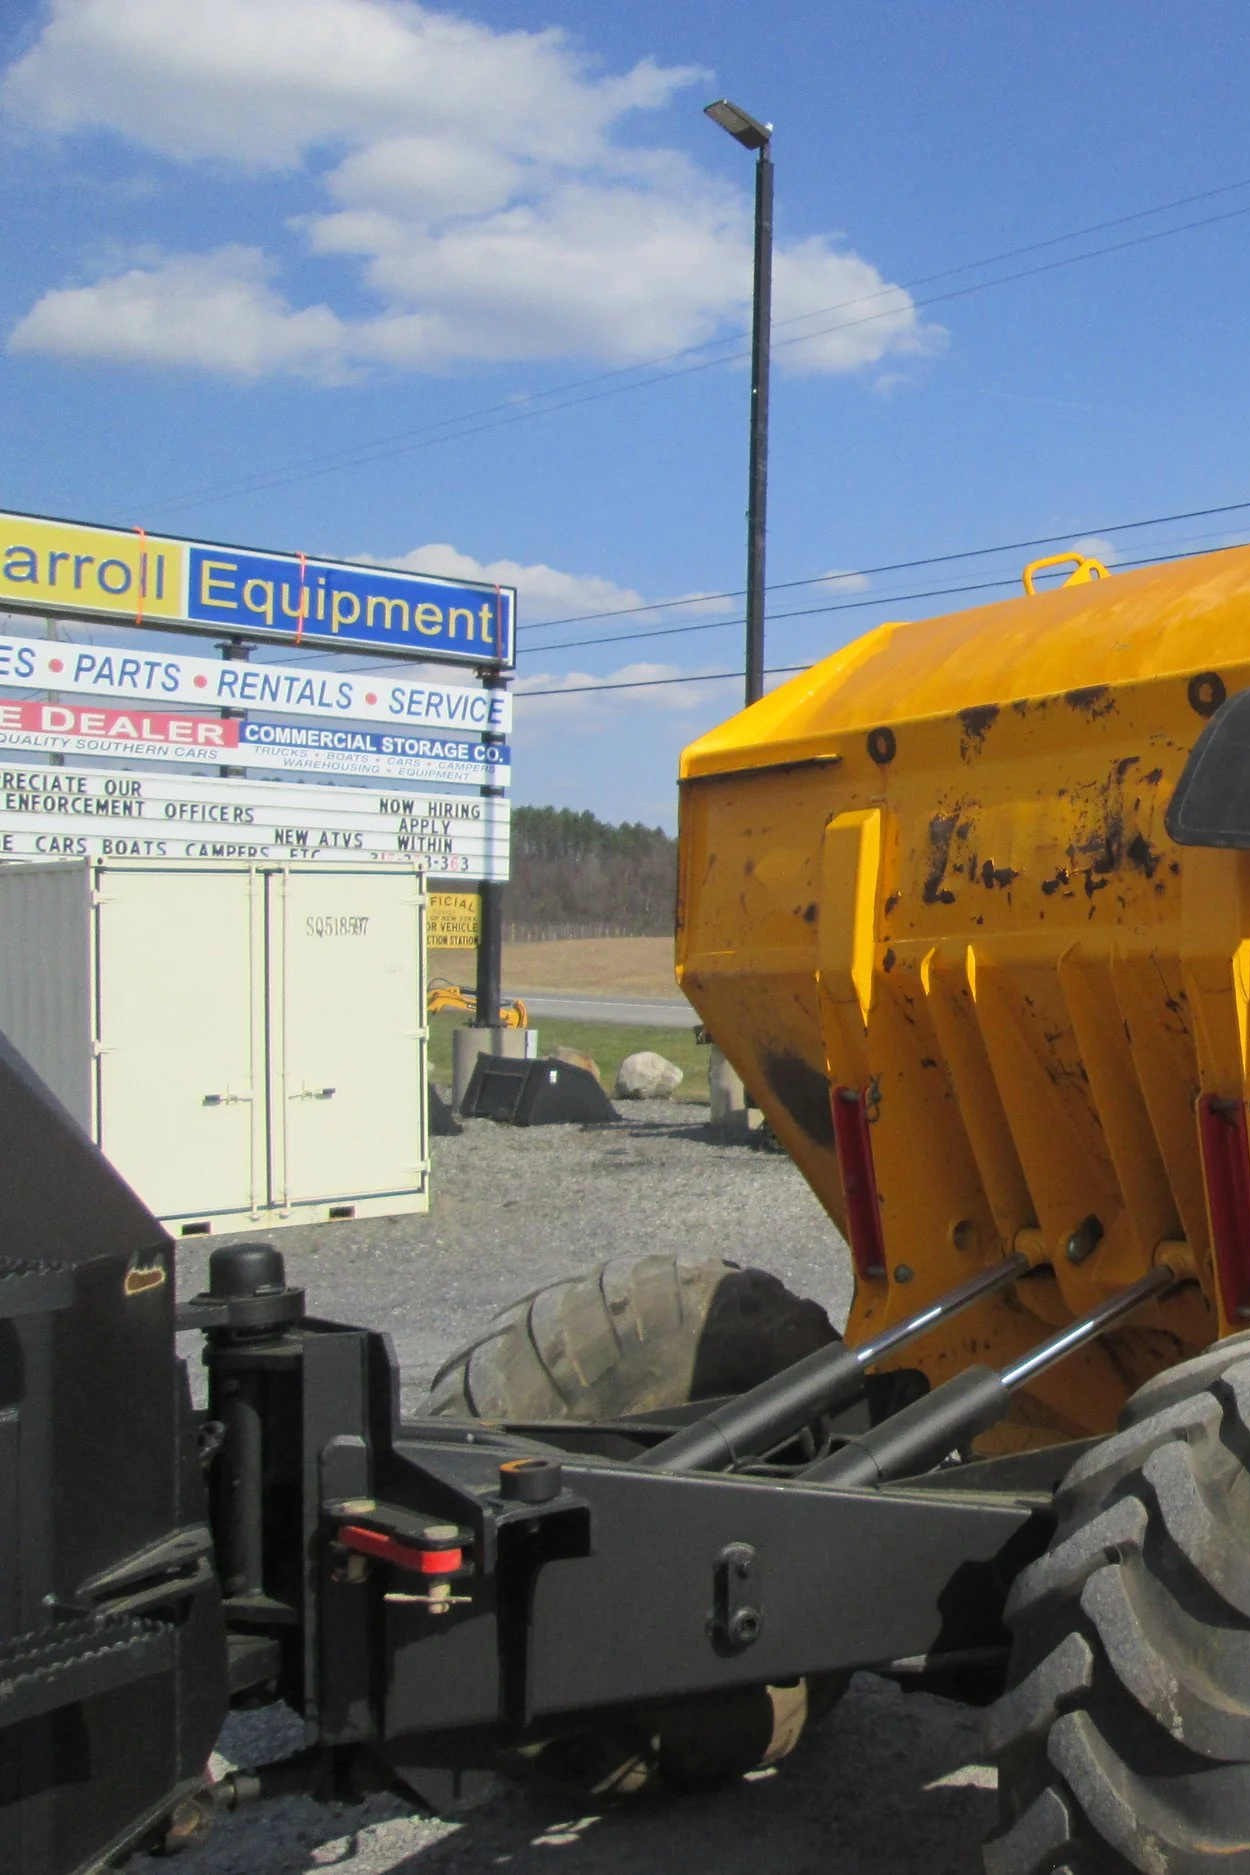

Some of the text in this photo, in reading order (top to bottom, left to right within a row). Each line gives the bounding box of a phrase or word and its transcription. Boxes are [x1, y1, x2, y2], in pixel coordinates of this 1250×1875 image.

[200, 559, 494, 643] Equipment
[73, 653, 181, 692] PARTS
[216, 668, 354, 710] RENTALS
[388, 687, 505, 724] SERVICE
[41, 706, 225, 745] DEALER
[76, 738, 169, 756] SOUTHERN
[174, 746, 219, 760] CARS
[245, 724, 504, 762] COMMERCIAL STORAGE CO.
[253, 745, 496, 774] TRUCKS BOATS CARS CAMPERS
[283, 757, 471, 781] WAREHOUSING EQUIPMENT
[0, 770, 142, 797] RECIATE OUR
[5, 792, 254, 823] ENFORCEMENT OFFICERS
[380, 799, 481, 819] NOW HIRING
[275, 828, 363, 849] NEW ATVS
[399, 818, 451, 835] APPLY
[35, 836, 88, 854] CARS
[102, 839, 167, 856] BOATS
[397, 835, 453, 854] WITHIN
[440, 922, 478, 933] VEHICLE
